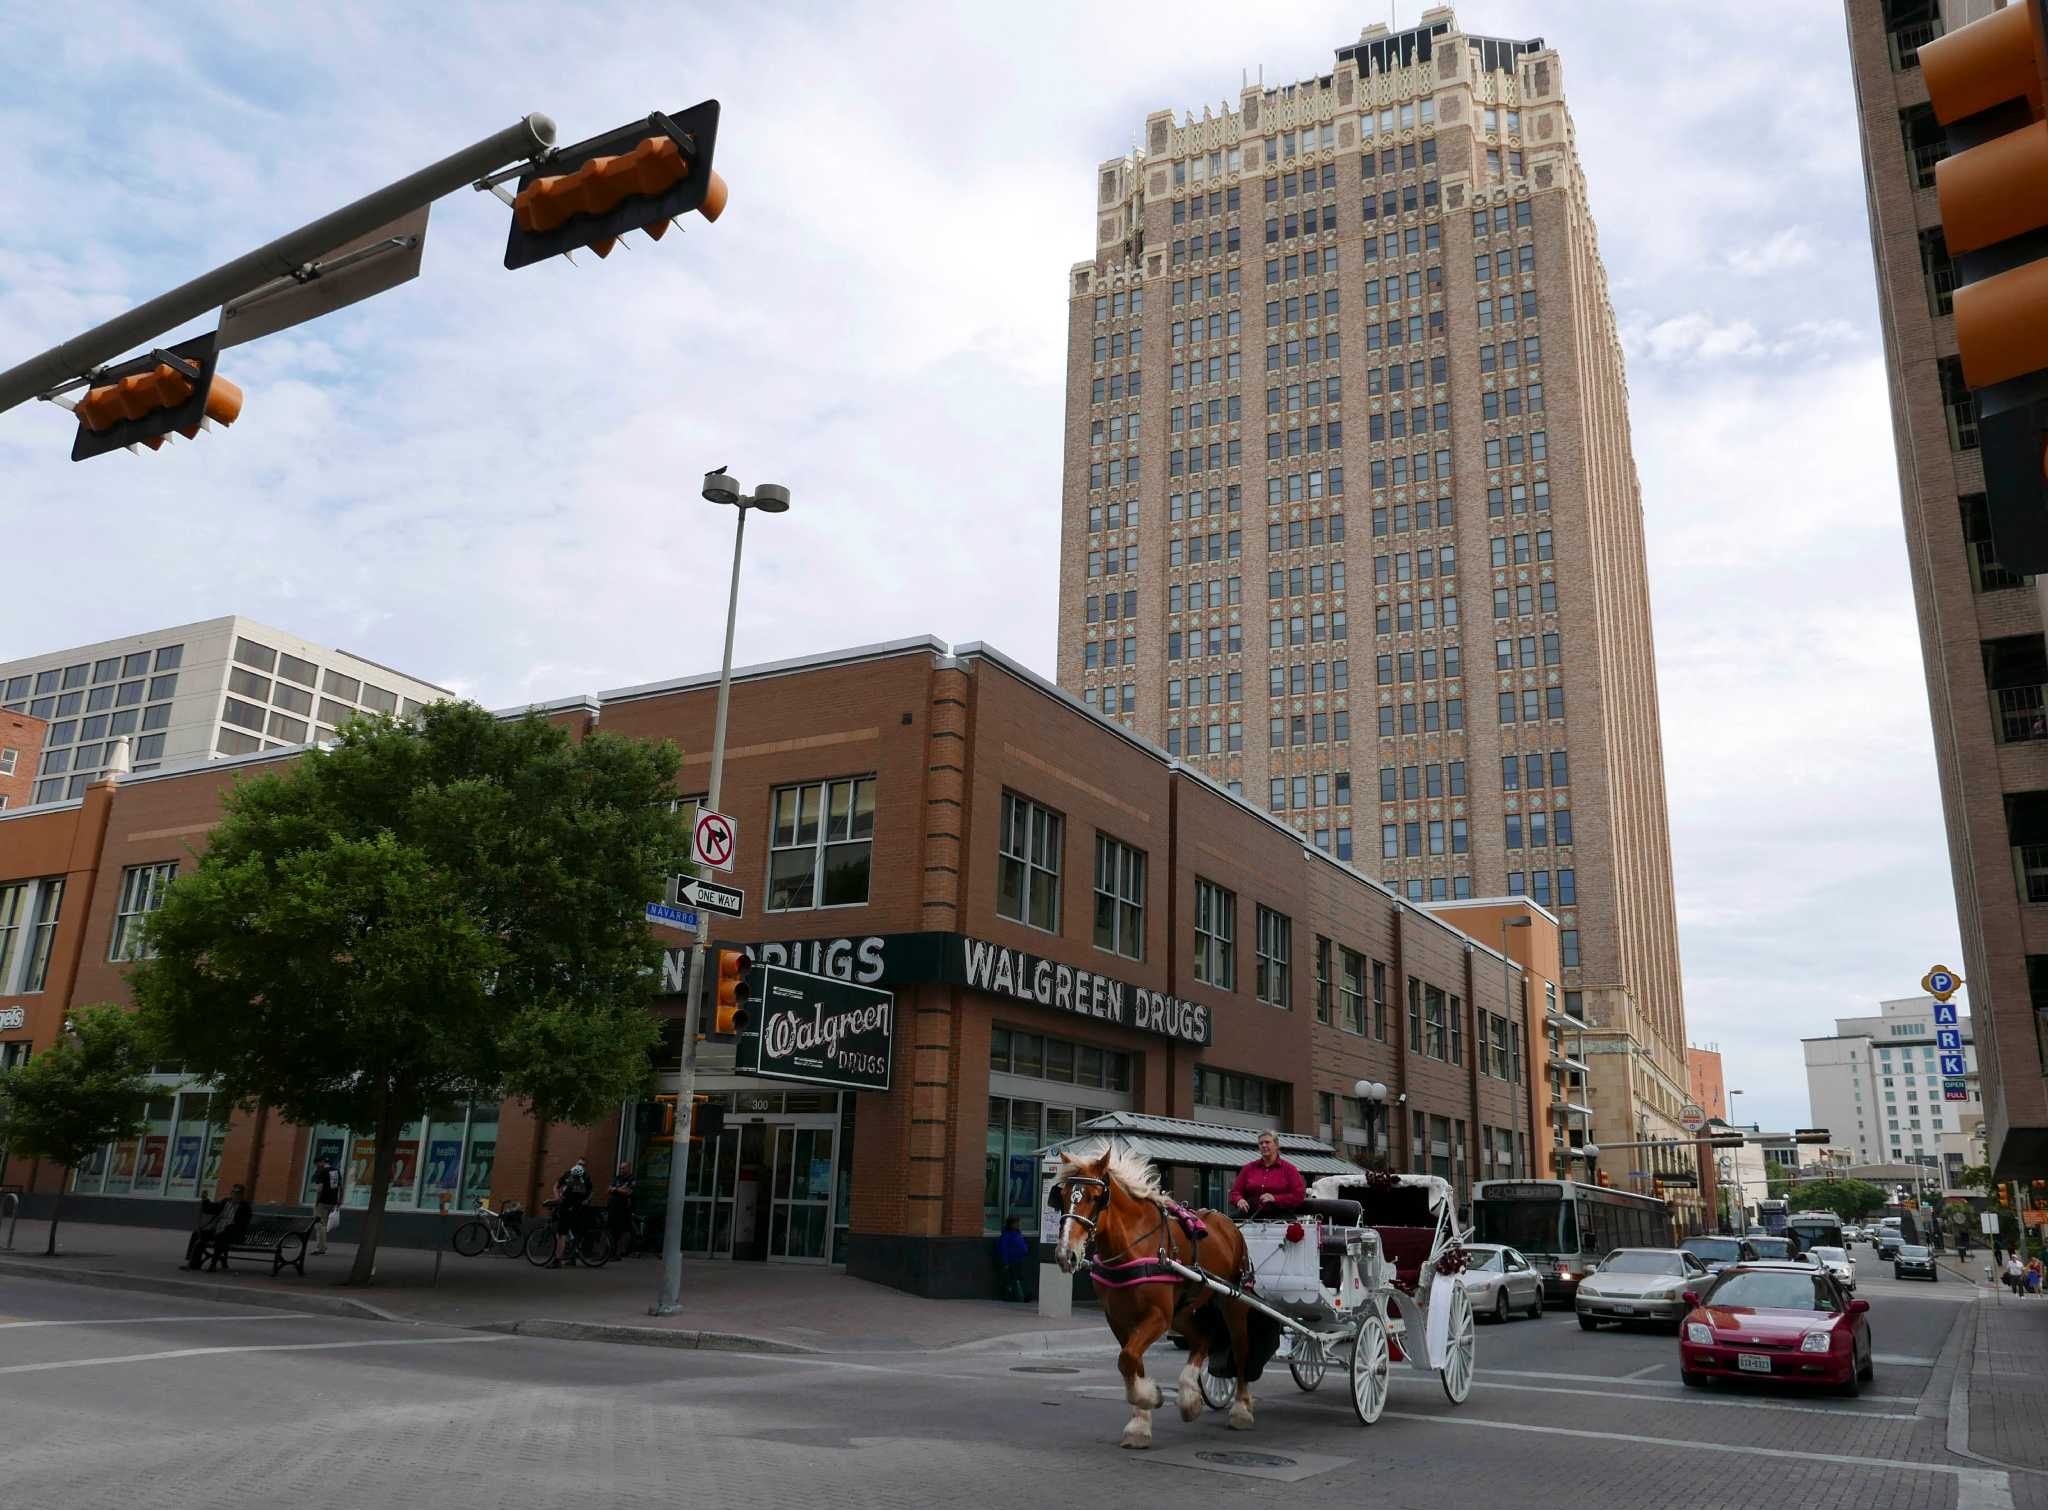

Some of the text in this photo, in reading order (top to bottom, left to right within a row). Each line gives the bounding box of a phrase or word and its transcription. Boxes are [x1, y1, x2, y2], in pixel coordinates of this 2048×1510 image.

[697, 889, 737, 908] ONE WAY
[649, 904, 695, 924] NAVARRO
[745, 936, 886, 984] UGS
[963, 937, 1208, 1042] WALGREEN DRUGS
[764, 1002, 890, 1059] Walgreen
[838, 1051, 886, 1074] DRUGS
[751, 1098, 769, 1111] 300
